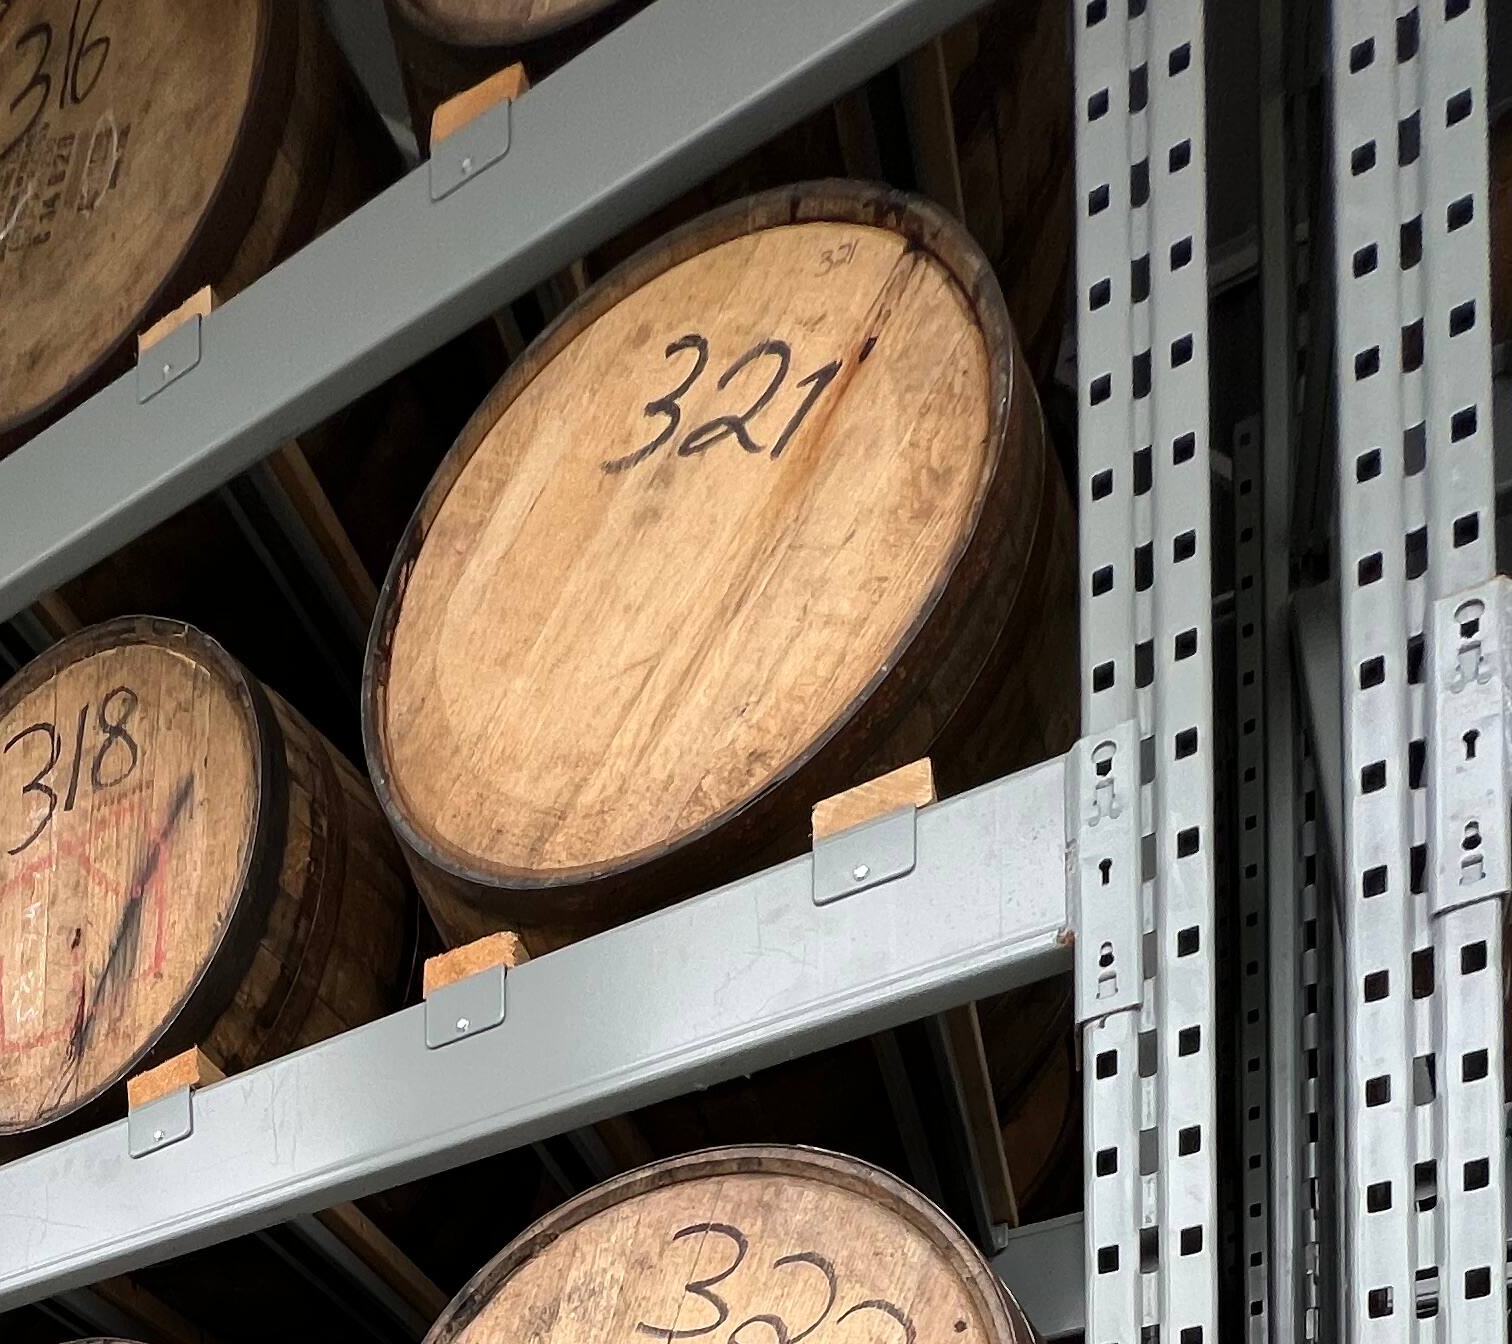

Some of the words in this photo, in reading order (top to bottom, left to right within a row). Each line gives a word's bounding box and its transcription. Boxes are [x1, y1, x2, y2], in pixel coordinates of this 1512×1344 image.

[0, 0, 111, 162] 316
[814, 240, 856, 277] 321
[601, 333, 844, 475] 321
[4, 685, 140, 857] 318
